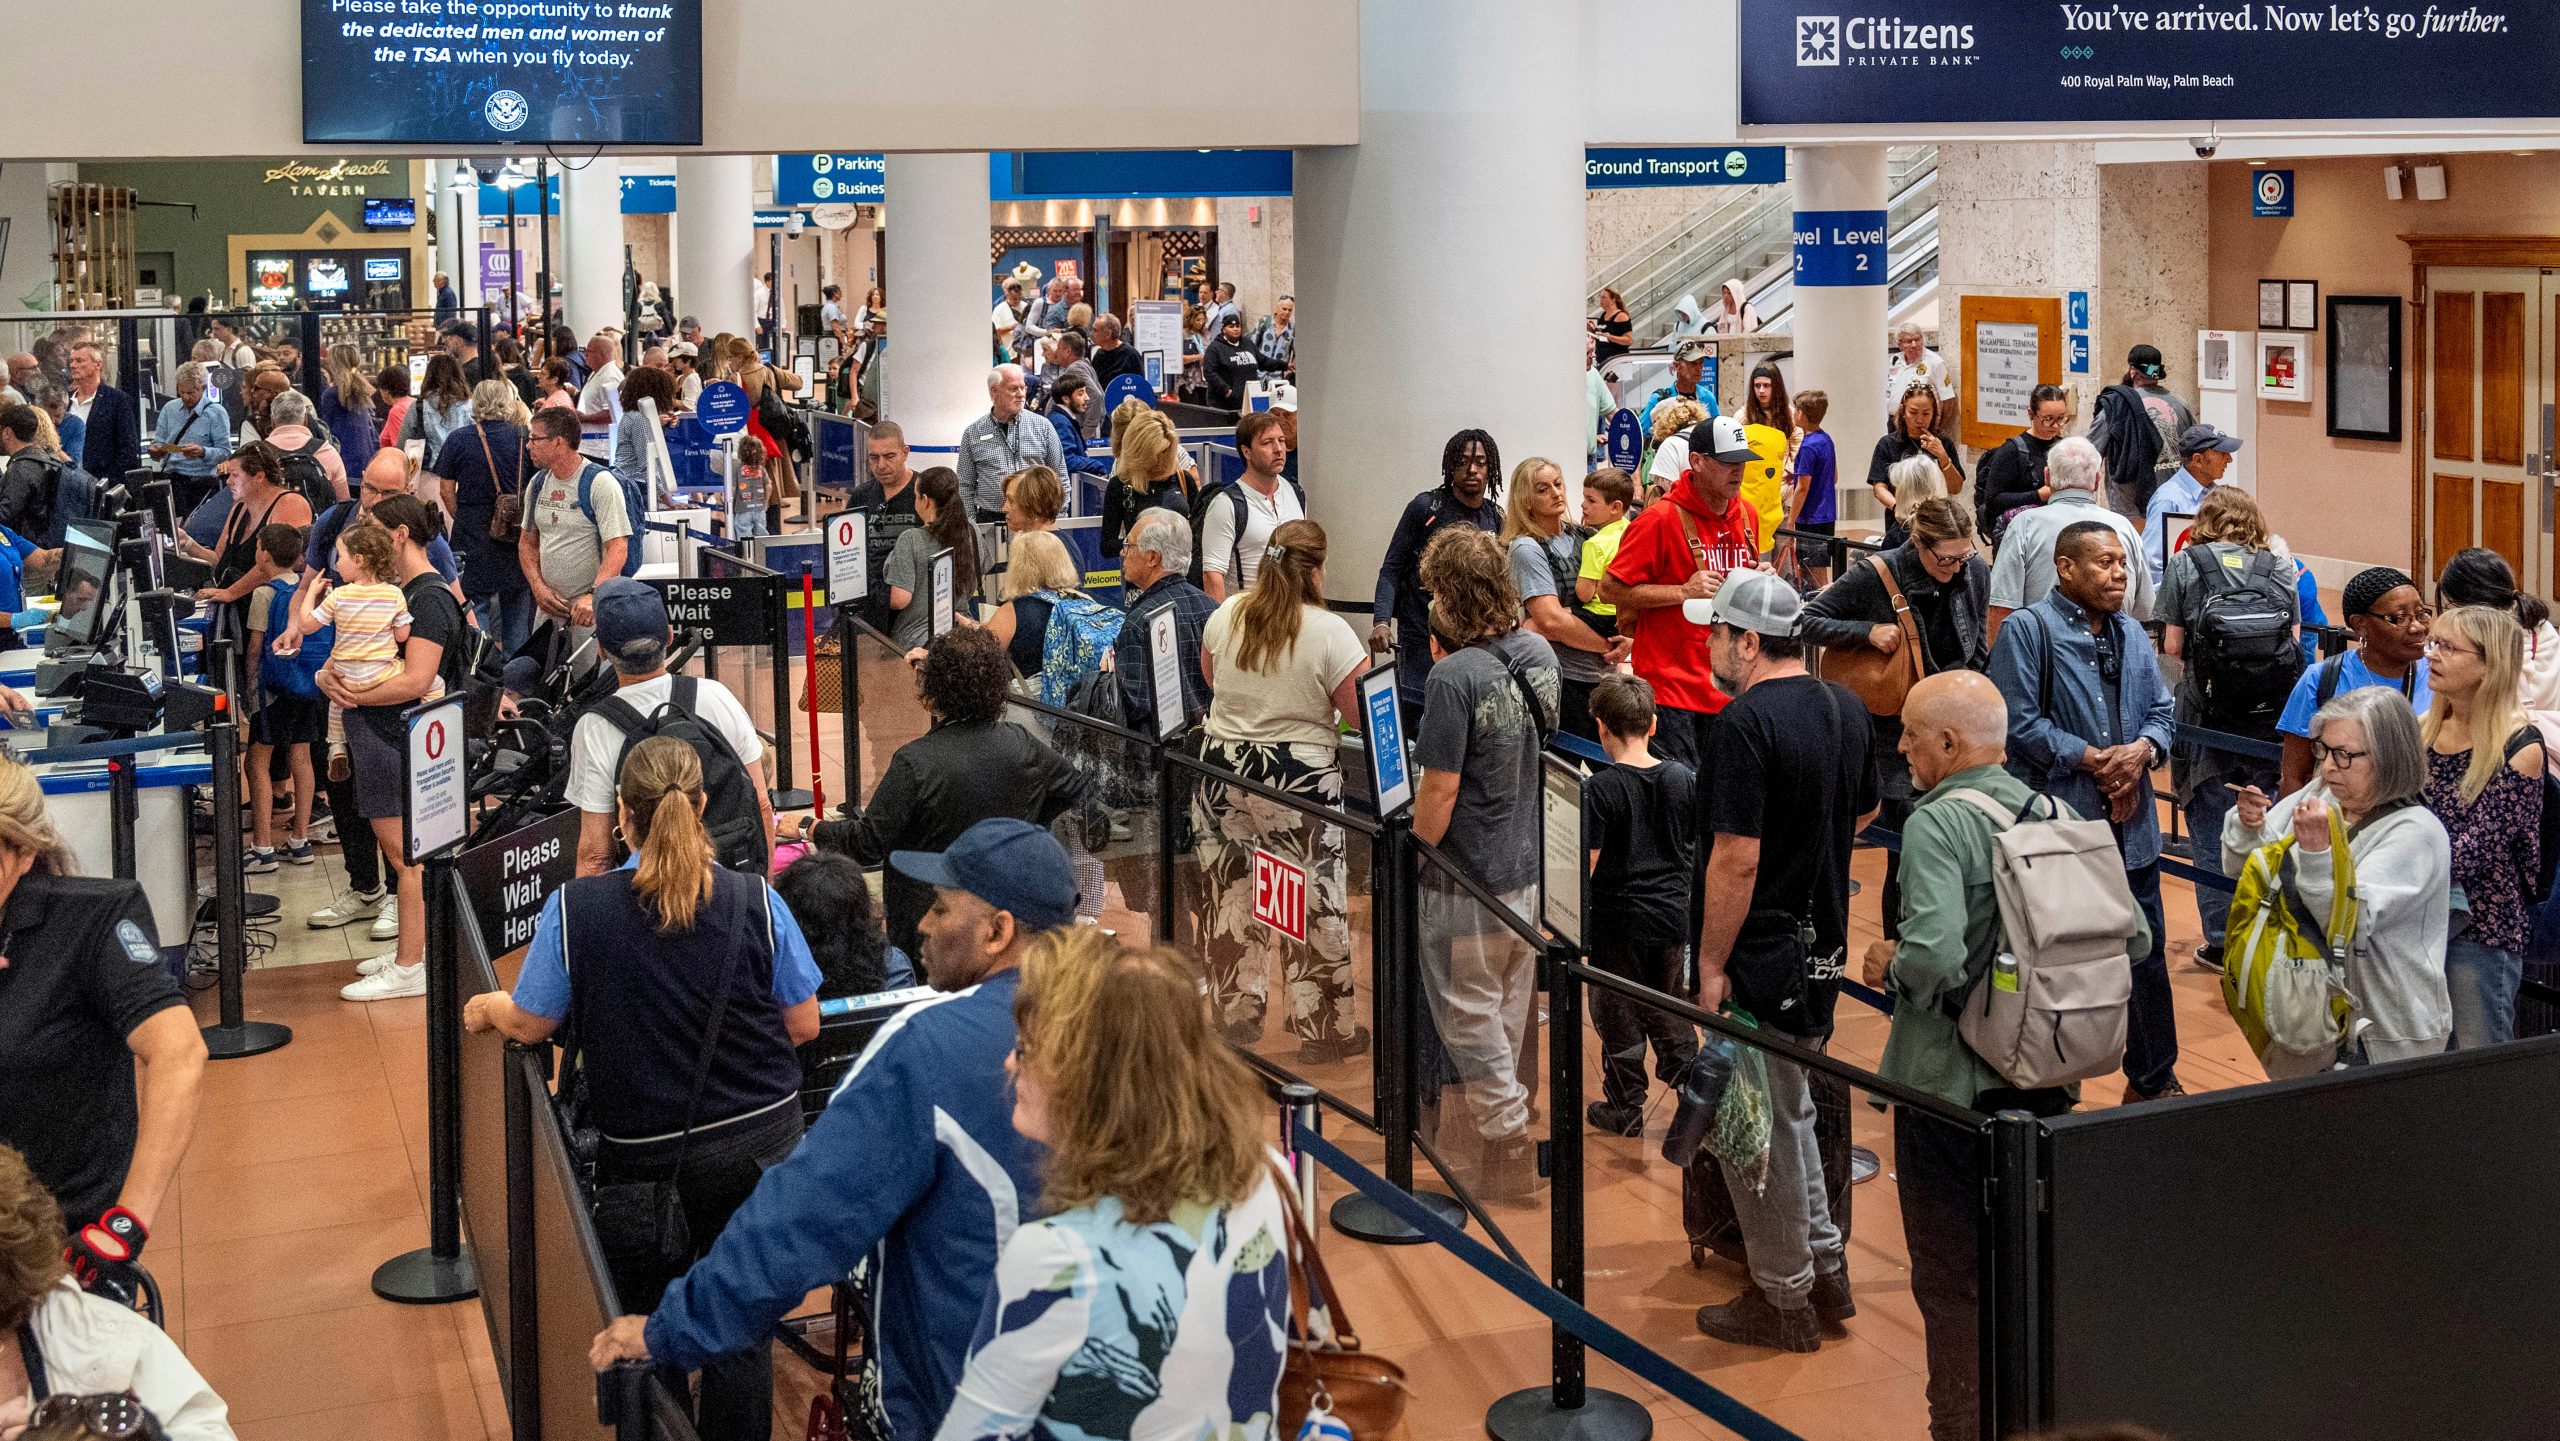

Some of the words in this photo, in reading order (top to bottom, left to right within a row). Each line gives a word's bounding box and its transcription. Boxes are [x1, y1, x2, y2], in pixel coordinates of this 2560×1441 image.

[333, 0, 395, 13] Please
[401, 0, 441, 15] take
[447, 0, 477, 15] the
[482, 0, 590, 19] opportunity
[594, 4, 612, 18] to
[619, 3, 673, 19] thank
[2060, 4, 2148, 31] You've
[2156, 5, 2258, 31] arrived.
[2265, 6, 2323, 31] Now
[2329, 6, 2380, 31] let's
[2385, 14, 2415, 39] go
[2417, 5, 2508, 39] further.
[342, 22, 374, 38] the
[380, 21, 478, 40] dedicated
[482, 26, 524, 41] men
[529, 25, 568, 41] and
[572, 29, 639, 42] women
[645, 27, 665, 42] of
[1845, 16, 1974, 51] Citizens
[374, 46, 406, 62] the
[413, 46, 451, 62] TSA
[456, 47, 507, 64] when
[513, 51, 546, 68] you
[552, 48, 574, 67] fly
[579, 49, 635, 66] today.
[1848, 56, 1918, 67] PRIVATE
[2061, 75, 2080, 87] 400
[2085, 74, 2114, 89] Royal
[2118, 75, 2143, 87] Palm
[2146, 75, 2170, 89] Way,
[2174, 75, 2199, 87] Palm
[2203, 75, 2233, 87] Beach
[263, 160, 320, 183] Sam
[838, 157, 884, 172] Parking
[1585, 158, 1642, 177] Ground
[1647, 158, 1719, 179] Transport
[290, 184, 366, 197] TAVERN
[838, 182, 884, 195] Busines
[753, 214, 789, 225] Restroom
[1792, 226, 1821, 246] evel
[1833, 227, 1883, 245] Level
[1795, 254, 1803, 271] 2
[1856, 254, 1868, 271] 2
[2013, 339, 2037, 349] TERMINAL
[1084, 575, 1122, 585] Welcome
[667, 584, 732, 601] Please
[667, 603, 711, 621] Wait
[503, 837, 560, 880] Please
[502, 872, 542, 913] Wait
[1255, 854, 1304, 934] EXIT
